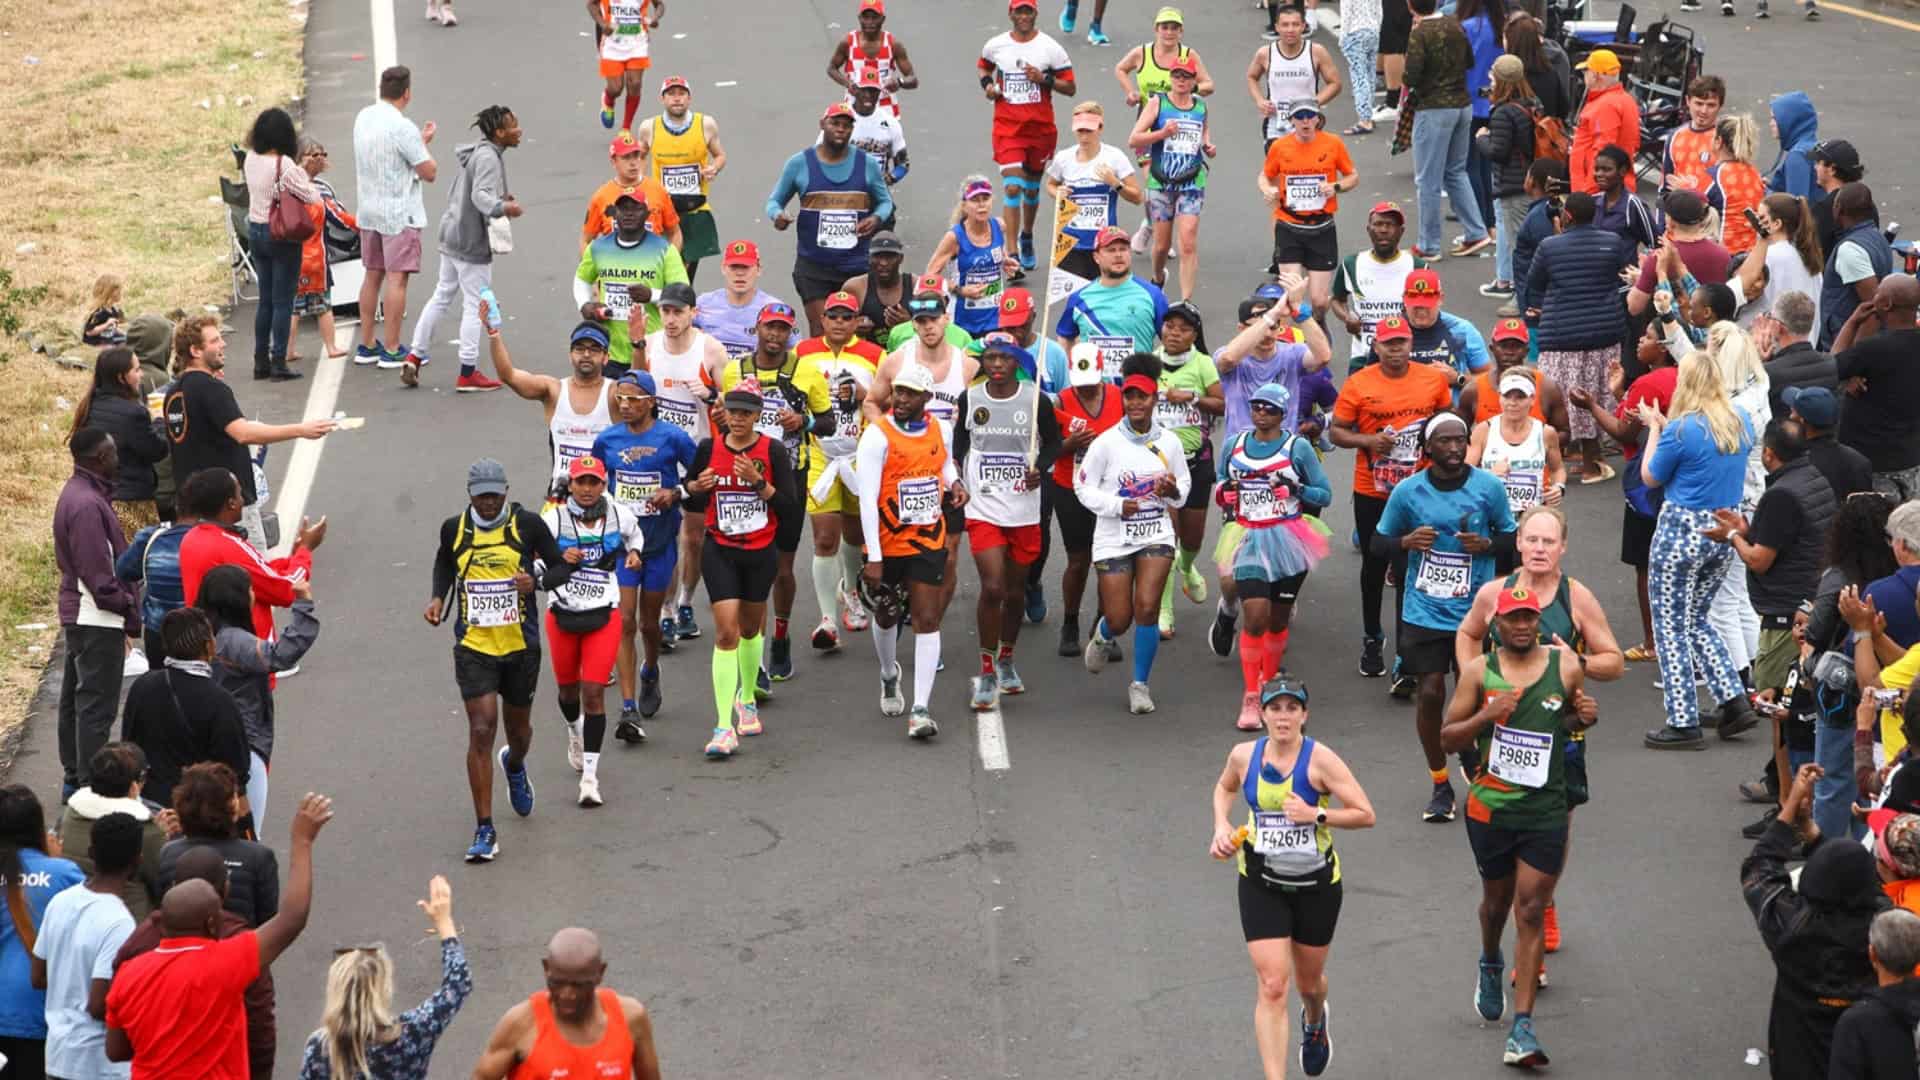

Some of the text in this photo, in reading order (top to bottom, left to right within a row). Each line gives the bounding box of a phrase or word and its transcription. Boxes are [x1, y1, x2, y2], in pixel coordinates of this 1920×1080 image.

[844, 424, 858, 437] 40
[984, 467, 1023, 480] F17603
[1125, 520, 1163, 538] F20772
[1426, 565, 1463, 584] D5945
[565, 581, 605, 599] G58189
[1452, 584, 1469, 597] 40
[472, 594, 513, 610] D57825
[503, 608, 518, 621] 40
[1498, 745, 1540, 767] F9883
[1261, 828, 1310, 849] F42675
